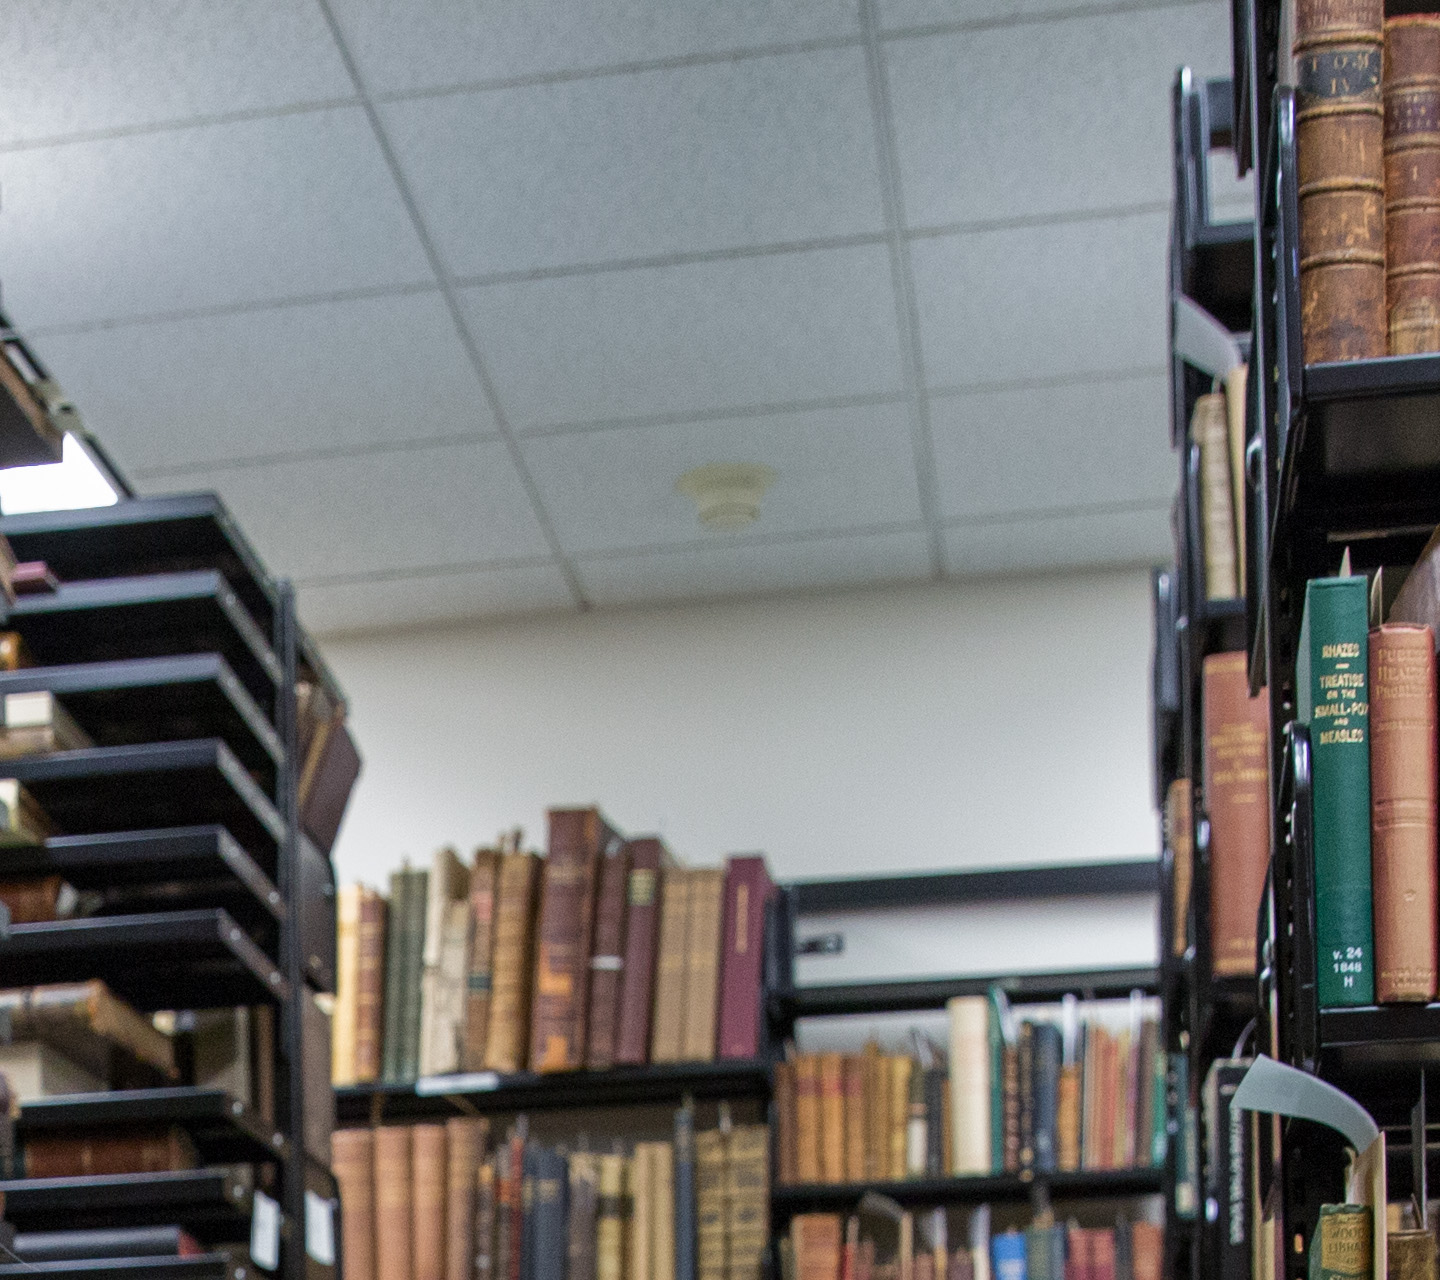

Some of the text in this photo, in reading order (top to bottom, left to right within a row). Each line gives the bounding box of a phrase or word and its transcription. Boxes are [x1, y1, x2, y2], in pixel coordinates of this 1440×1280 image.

[1322, 643, 1360, 658] RHAZES
[1319, 673, 1365, 689] TREATISE
[1341, 689, 1357, 699] THE
[1332, 717, 1349, 726] AND
[1319, 728, 1364, 745] MEASLES
[1346, 946, 1363, 959] 24
[1343, 976, 1354, 988] H
